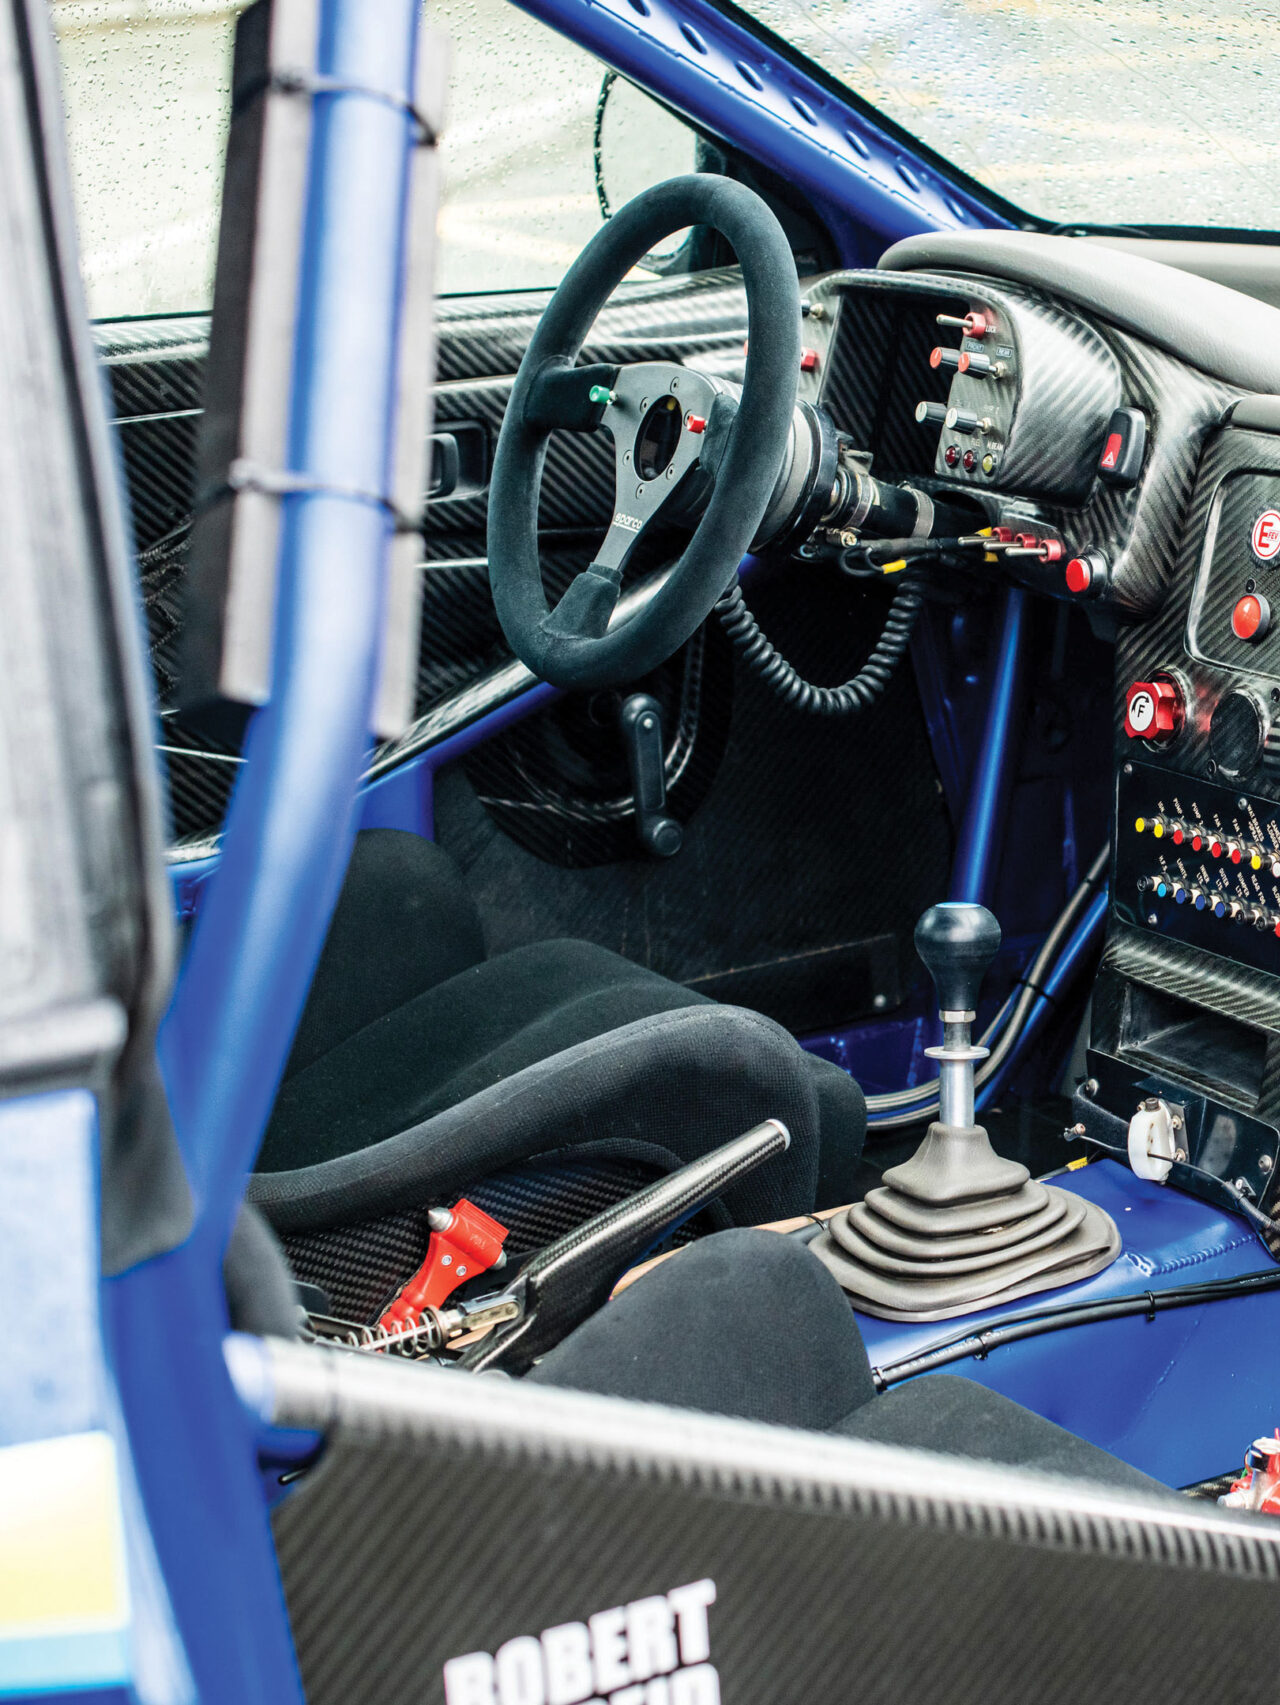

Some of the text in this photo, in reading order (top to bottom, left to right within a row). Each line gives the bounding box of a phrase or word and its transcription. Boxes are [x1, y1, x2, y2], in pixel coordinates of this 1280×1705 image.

[615, 512, 643, 530] sparco
[1258, 521, 1274, 548] E
[1138, 704, 1145, 718] F
[1173, 797, 1182, 814] PUMP
[1192, 802, 1201, 818] PUMP
[1232, 818, 1240, 832] FAN
[444, 1578, 717, 1705] ROBERT
